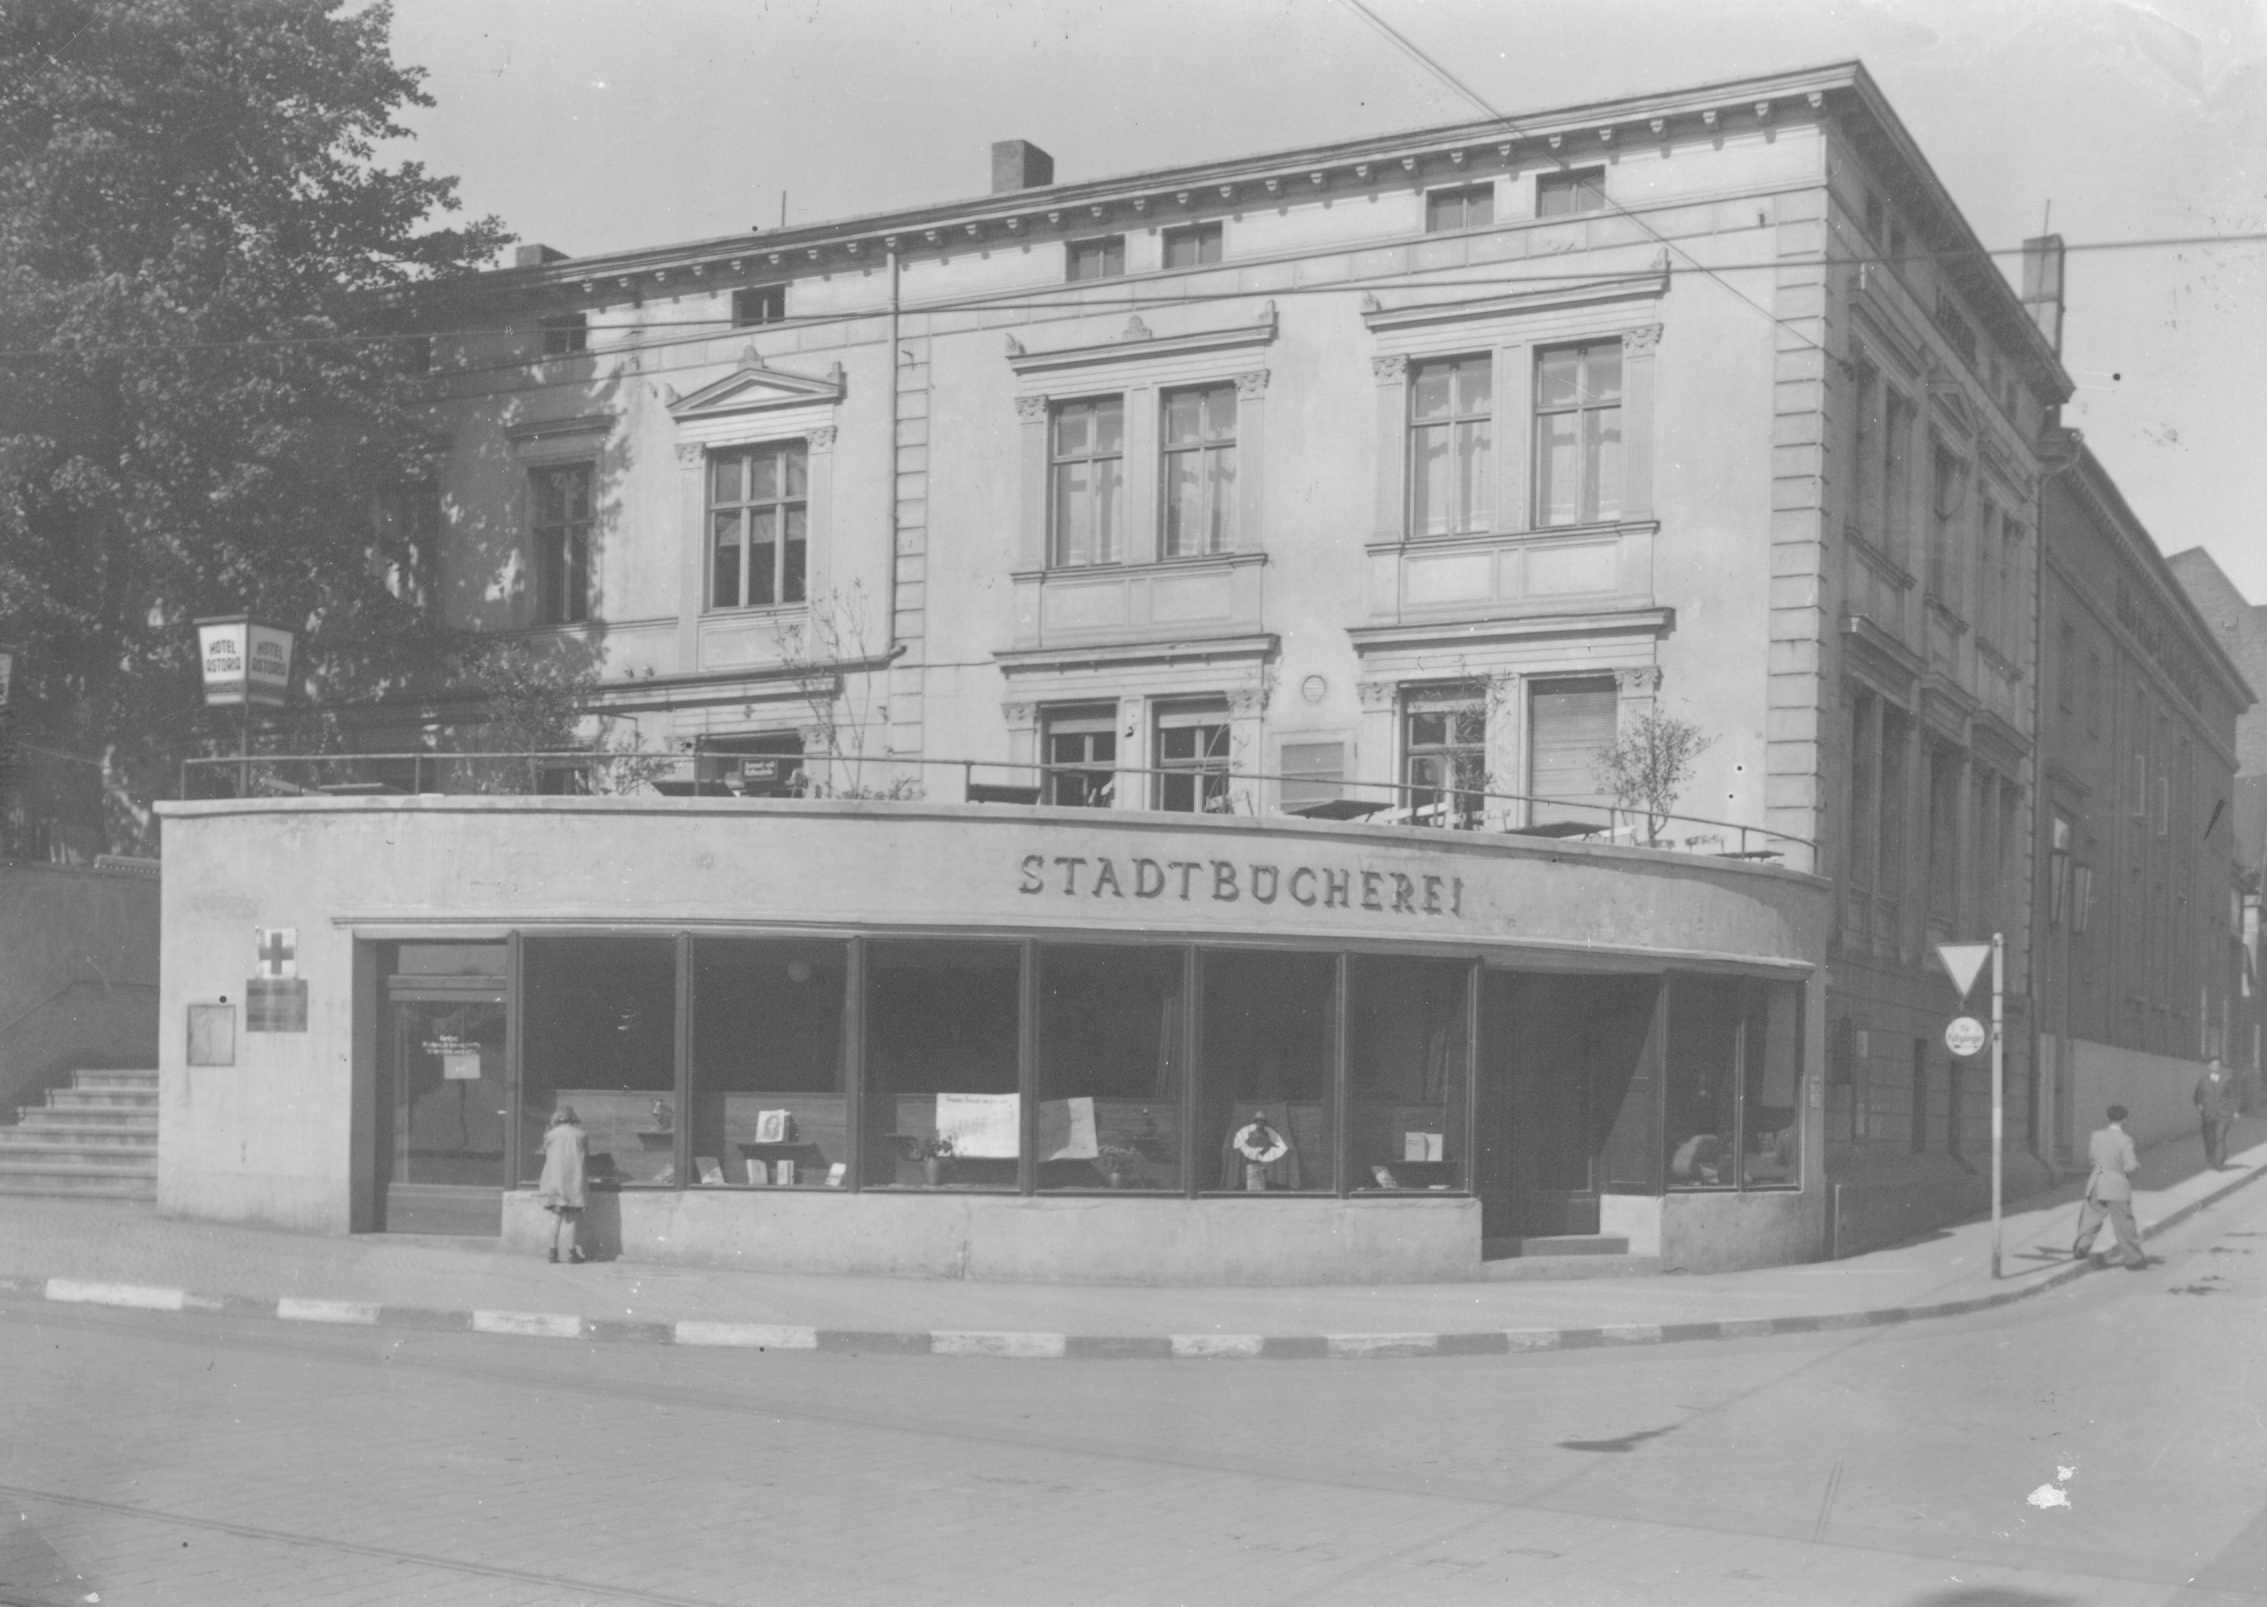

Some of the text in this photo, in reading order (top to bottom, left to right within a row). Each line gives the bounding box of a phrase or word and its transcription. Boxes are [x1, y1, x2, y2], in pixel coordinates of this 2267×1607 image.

[208, 639, 237, 655] HOTEL
[256, 642, 282, 661] HOTEL
[1018, 853, 1464, 918] STADTBÜCHEREI
